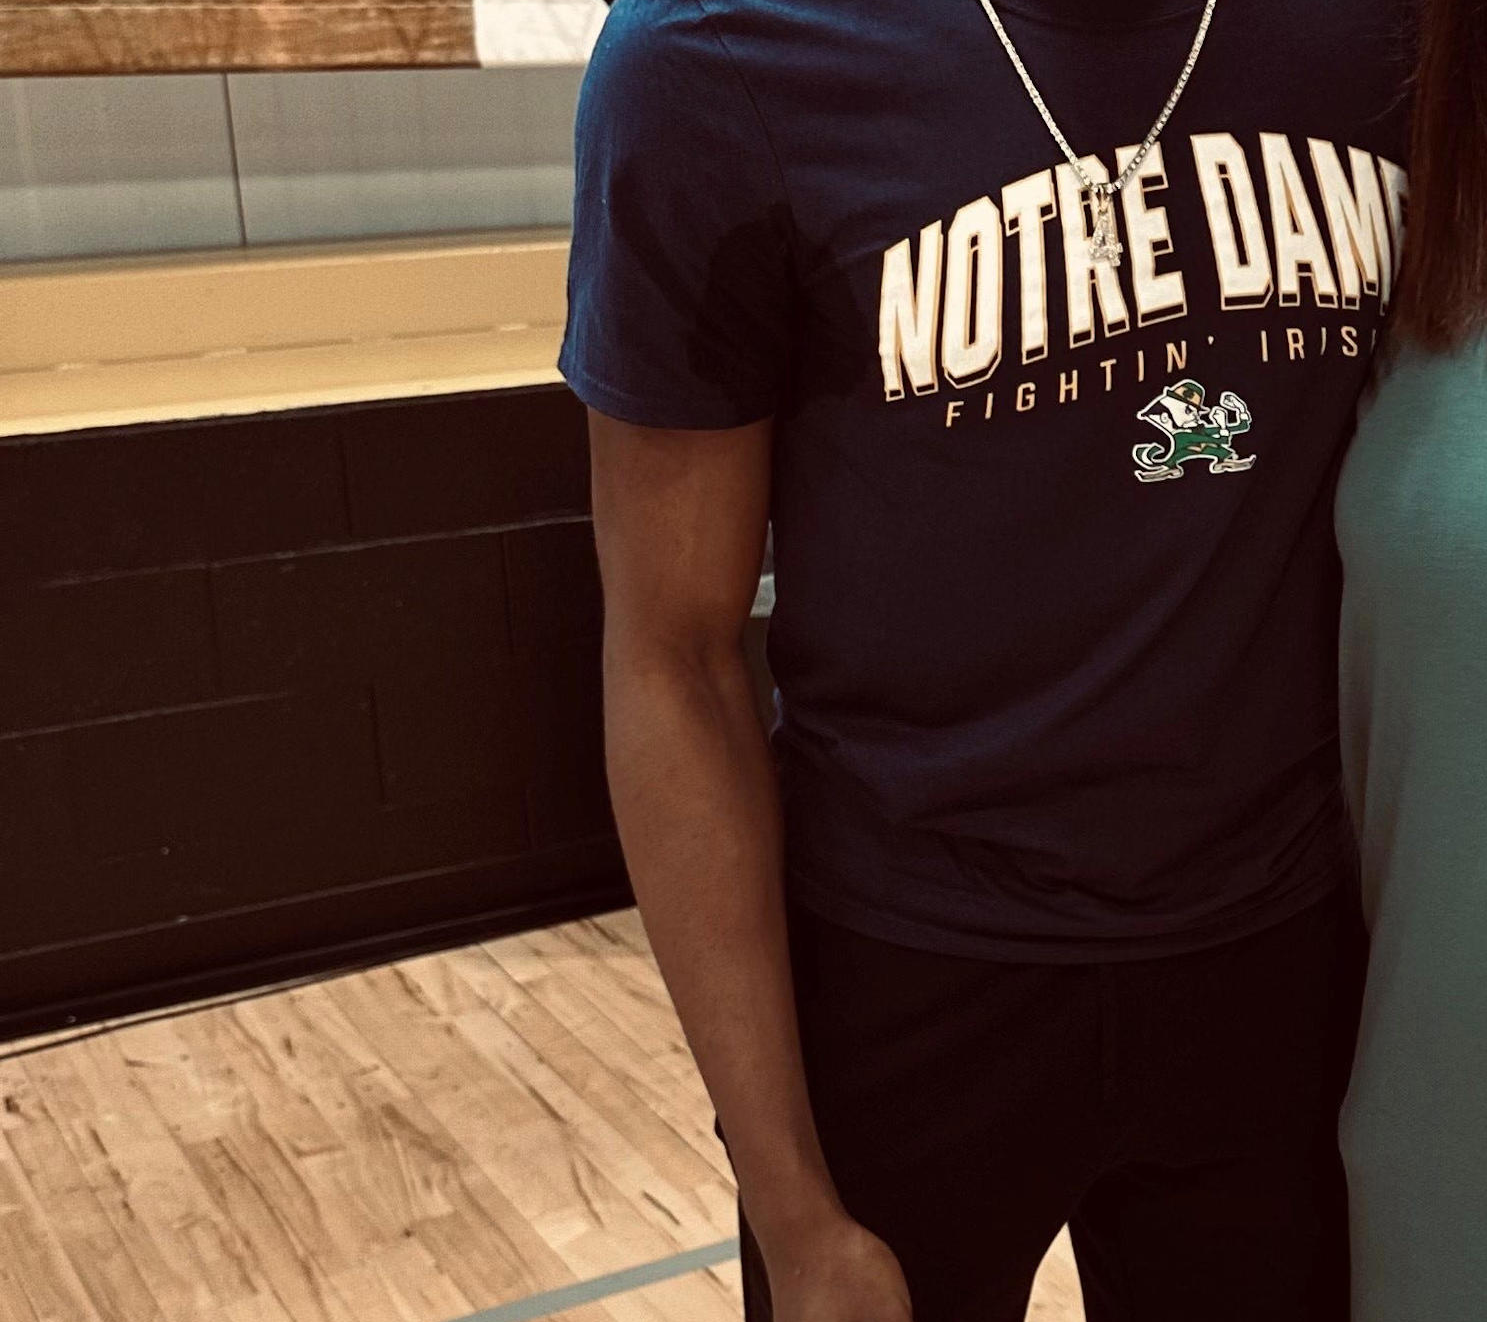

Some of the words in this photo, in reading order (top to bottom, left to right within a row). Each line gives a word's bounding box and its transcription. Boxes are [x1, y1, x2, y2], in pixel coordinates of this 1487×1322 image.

[879, 141, 1188, 403] NOTRE
[945, 335, 1216, 429] FIGHTIN'
[1261, 326, 1377, 363] IRIS
